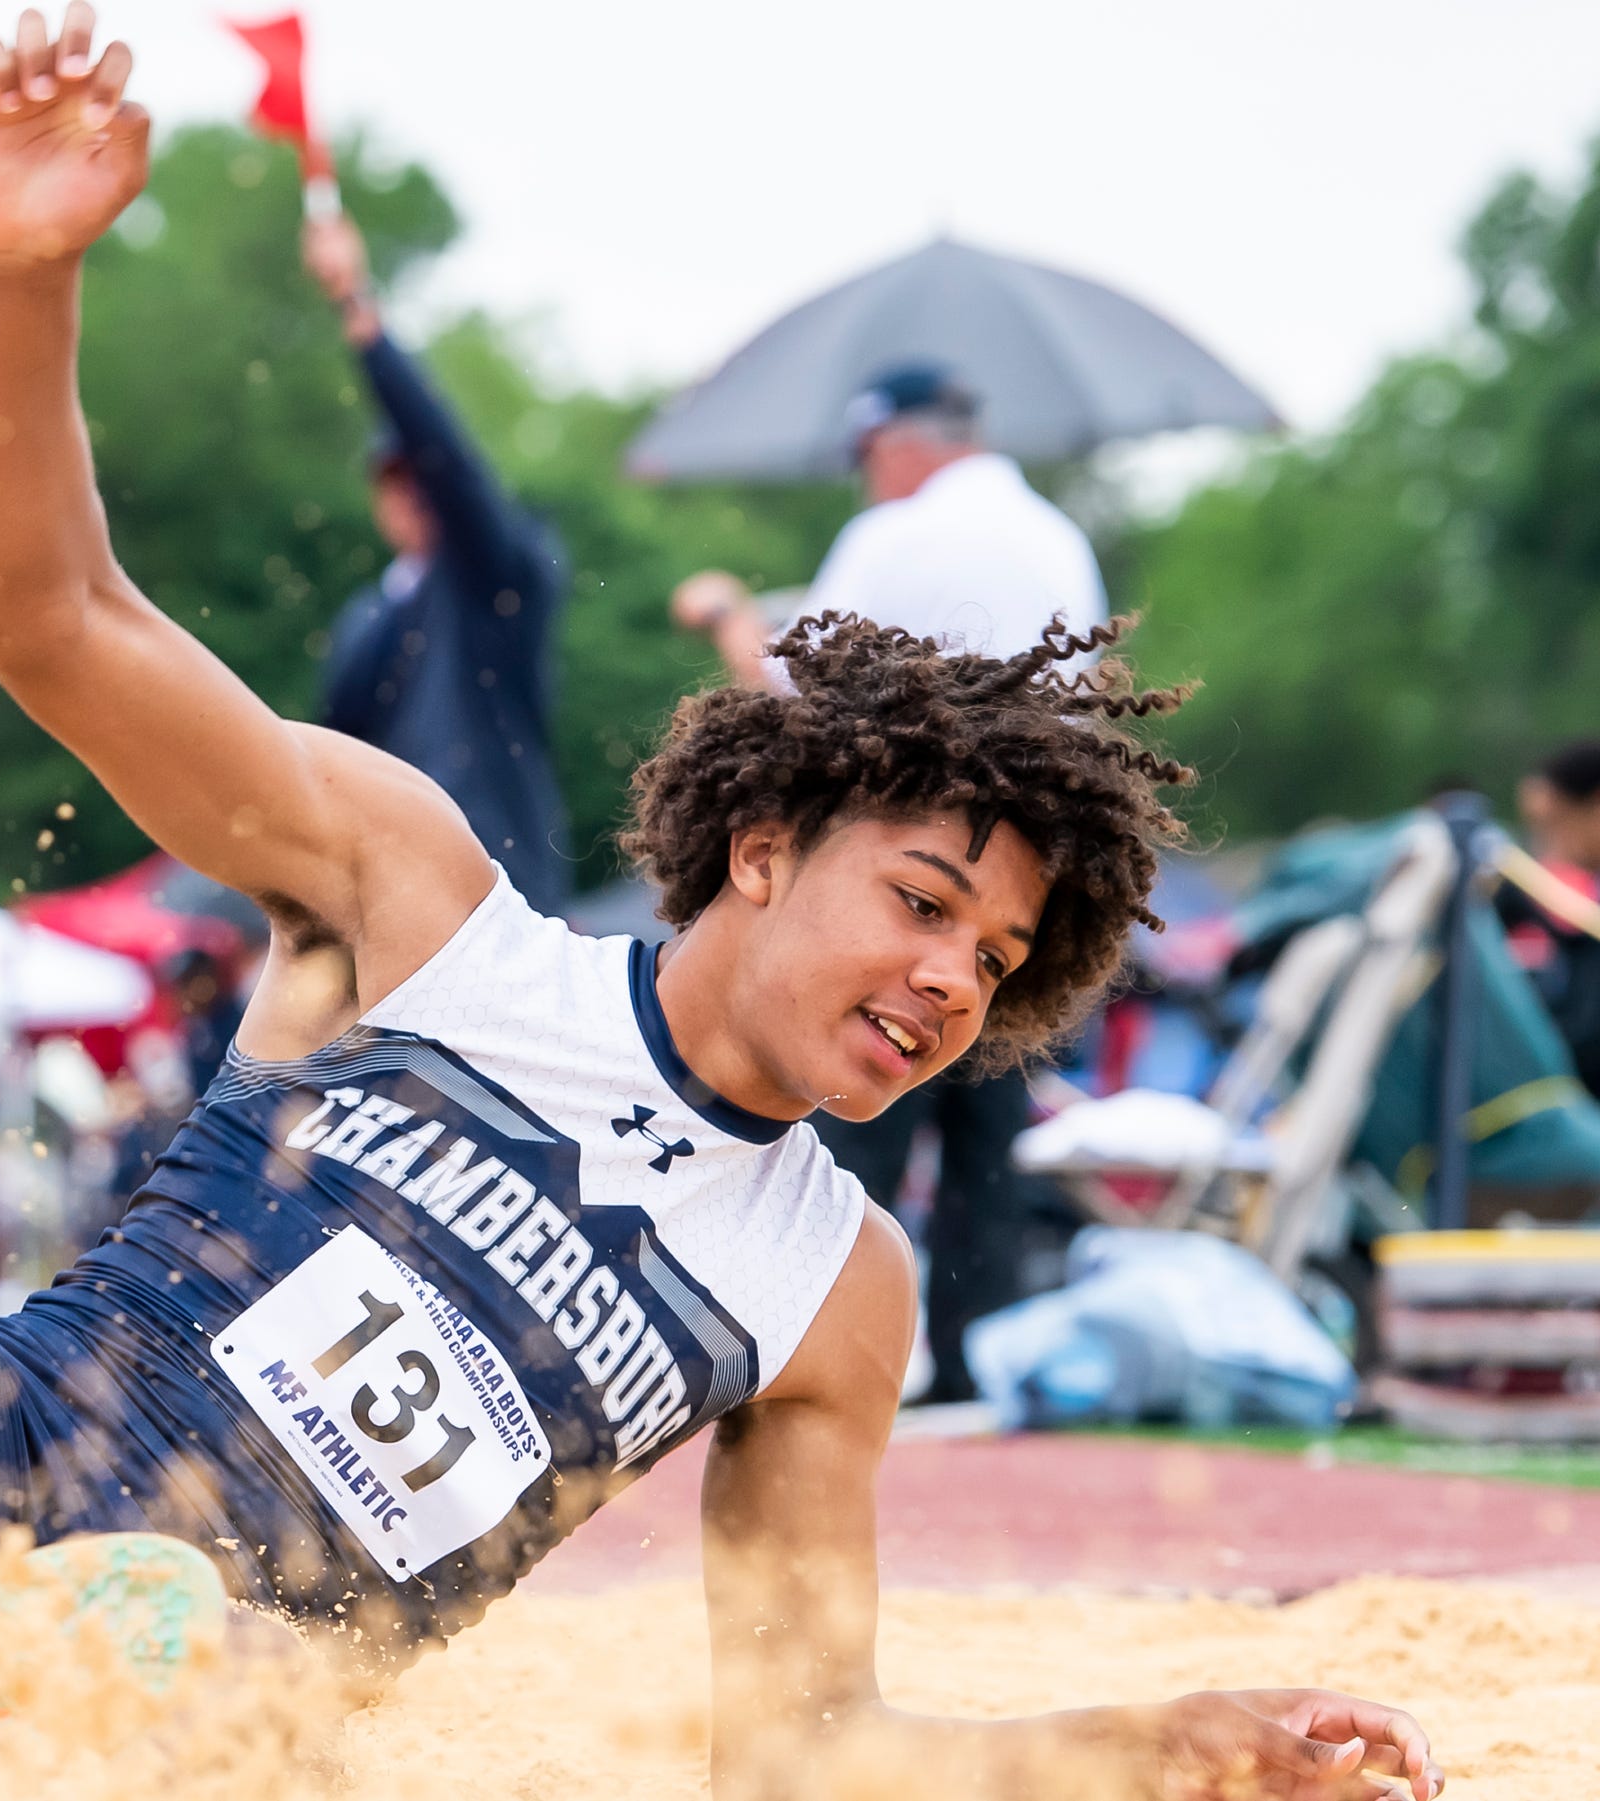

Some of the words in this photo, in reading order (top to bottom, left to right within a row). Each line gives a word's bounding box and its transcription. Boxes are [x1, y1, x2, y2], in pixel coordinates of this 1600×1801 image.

[310, 1289, 477, 1494] 131
[424, 1300, 453, 1341] FIELD
[448, 1340, 524, 1462] CHAMPIONSHIPS
[467, 1343, 505, 1393] AAA
[497, 1391, 537, 1454] BOYS
[292, 1405, 408, 1533] ATHLETIC
